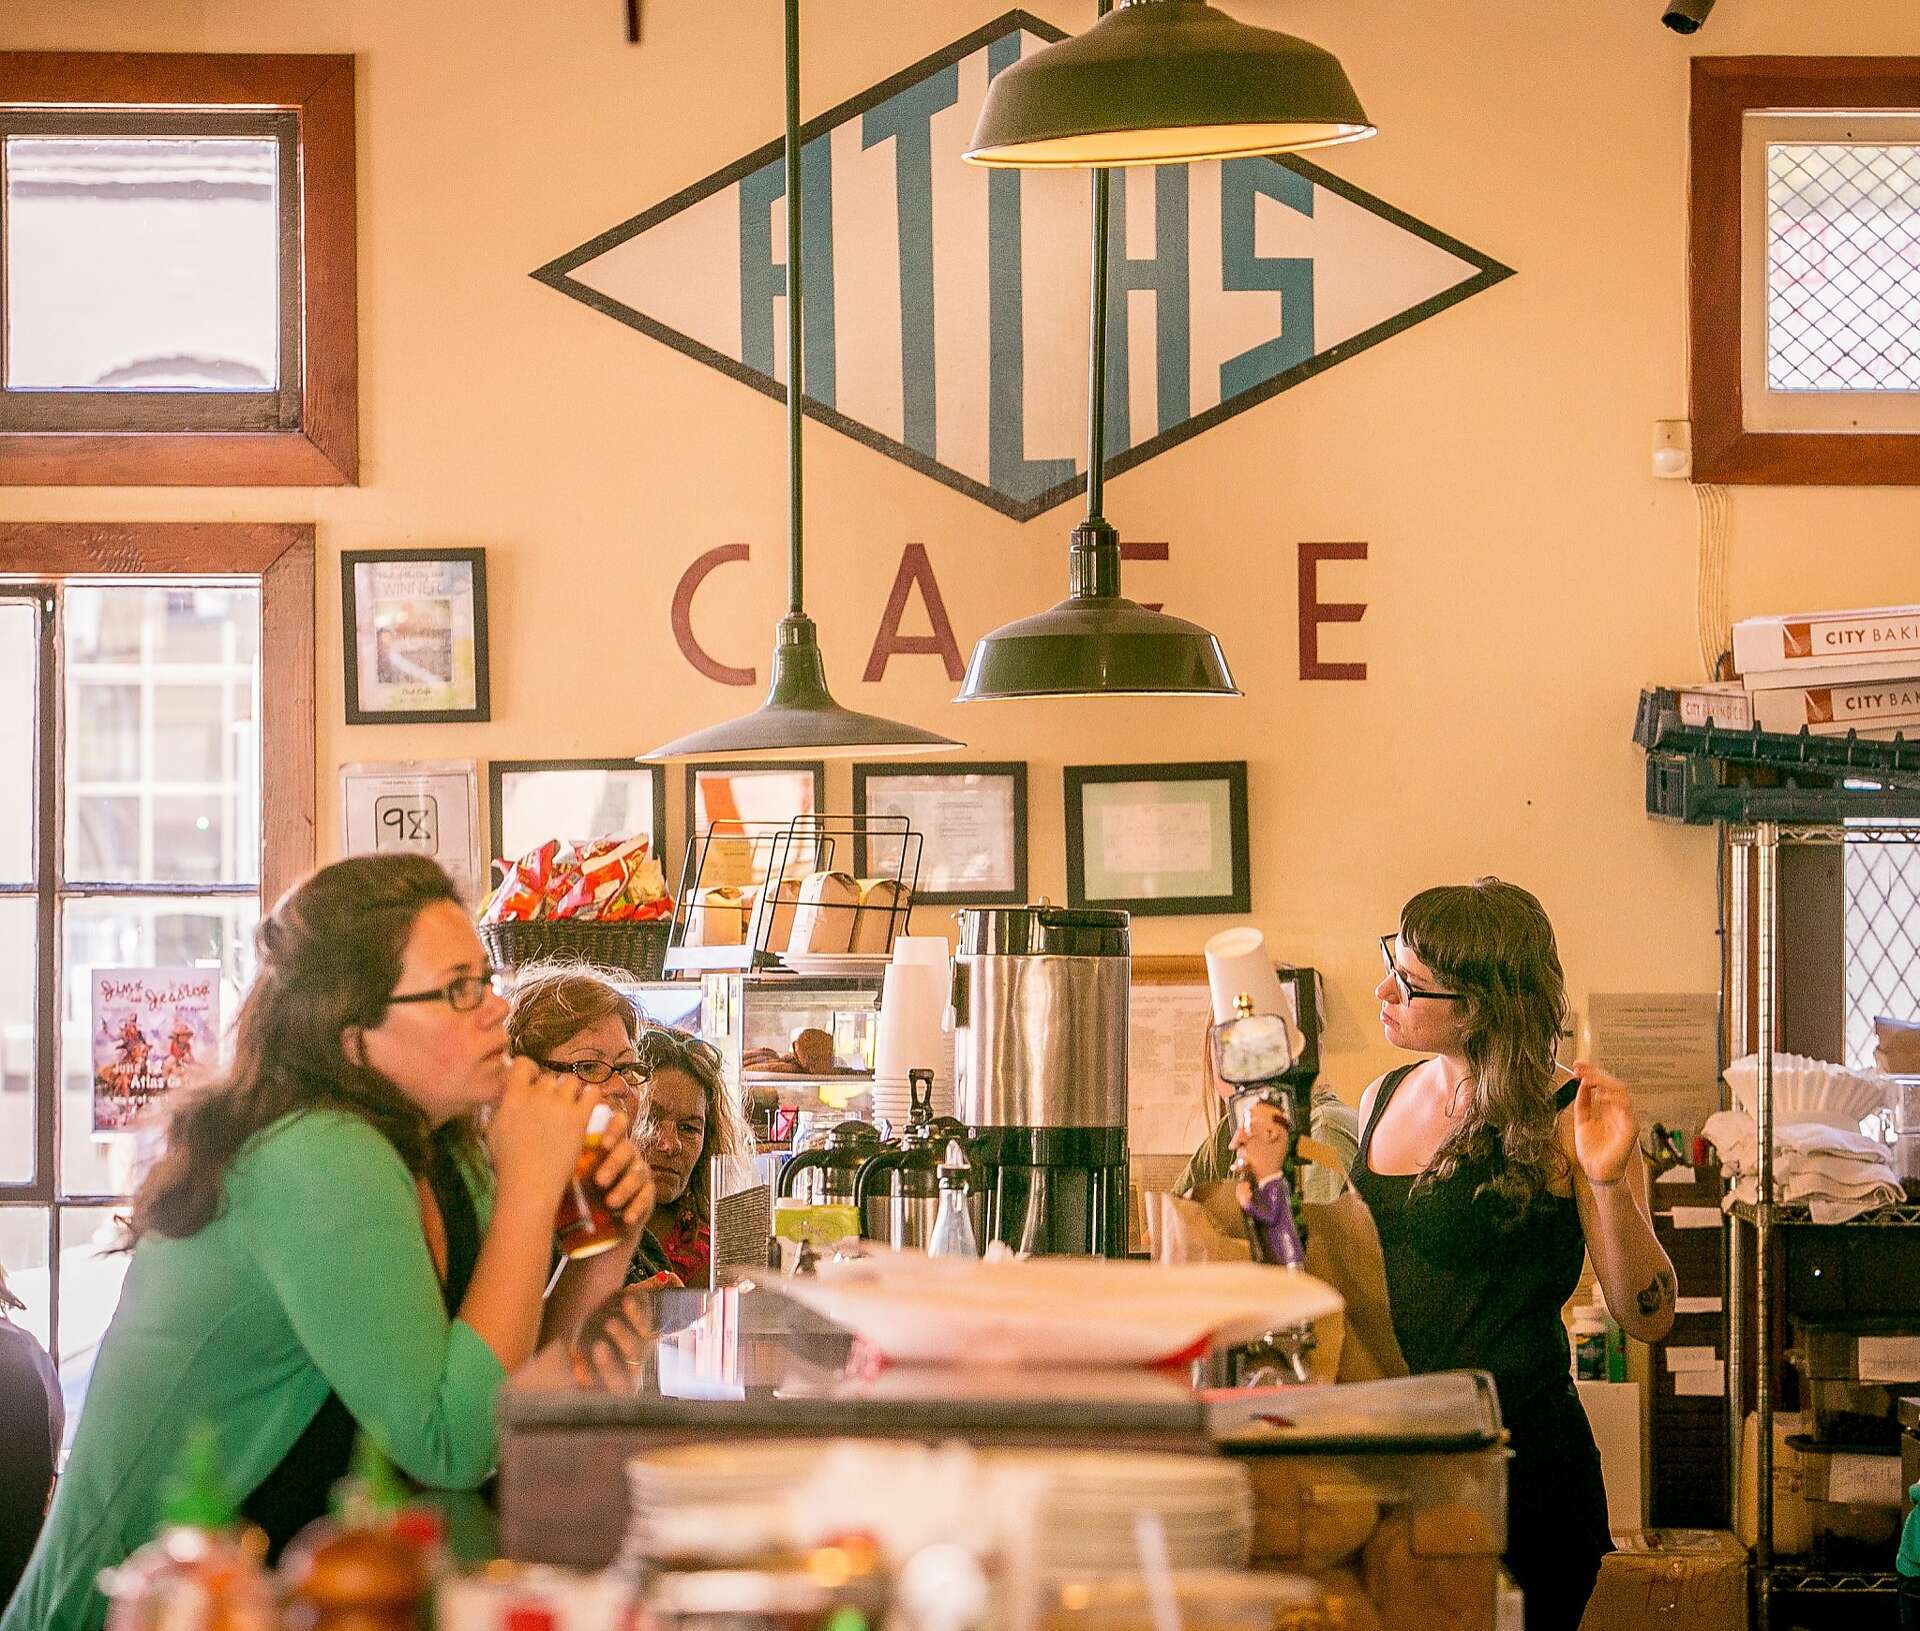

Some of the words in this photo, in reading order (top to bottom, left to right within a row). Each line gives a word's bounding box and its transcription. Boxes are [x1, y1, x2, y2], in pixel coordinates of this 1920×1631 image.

[740, 28, 1315, 502] ATLAS
[671, 542, 1369, 687] CAE
[1826, 630, 1866, 646] CITY
[1845, 694, 1884, 711] CITY
[382, 807, 432, 841] 98
